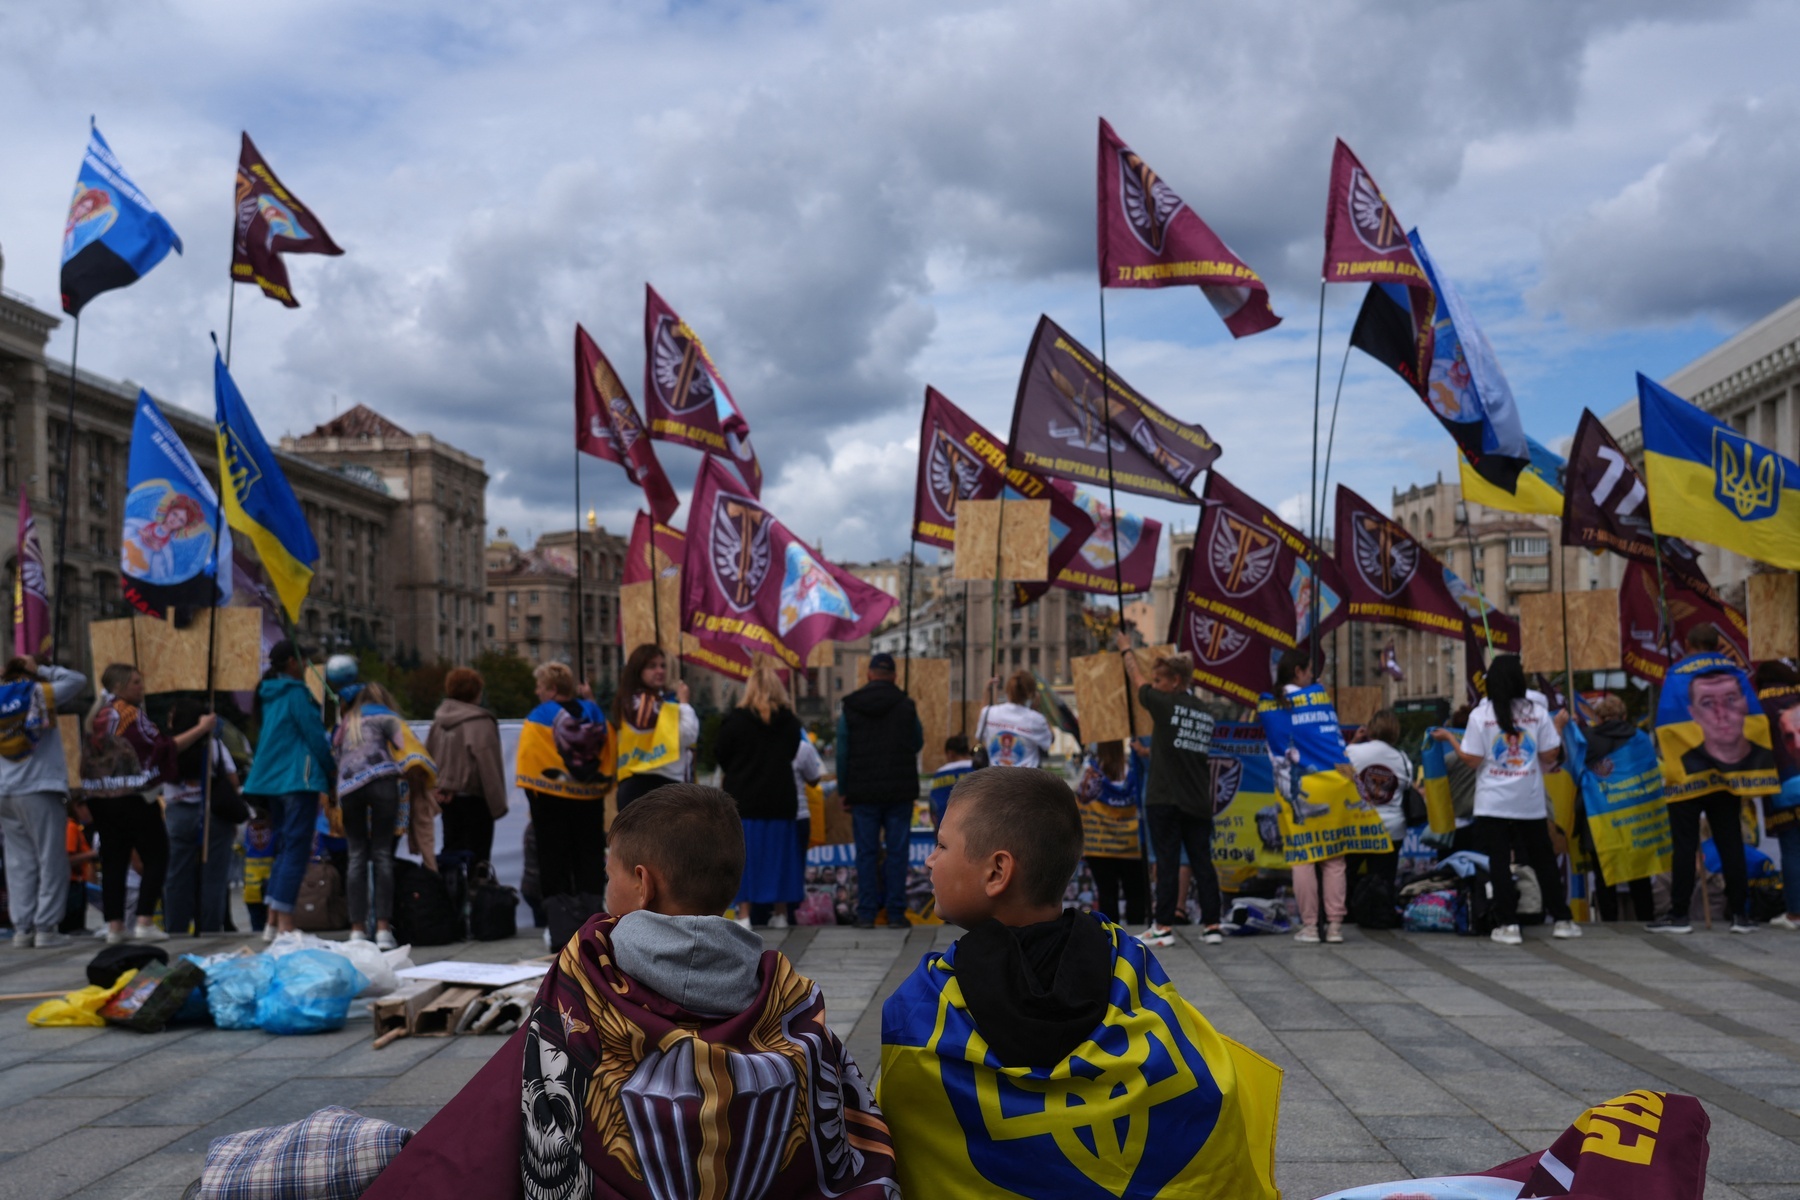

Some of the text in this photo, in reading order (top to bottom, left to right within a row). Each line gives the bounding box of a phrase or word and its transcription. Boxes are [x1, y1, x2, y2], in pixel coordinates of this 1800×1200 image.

[1337, 261, 1349, 276] 77
[1292, 711, 1328, 726] ВИХИЛЬ
[1324, 825, 1356, 842] СЕРЦЕ
[1310, 845, 1324, 858] ТИ
[1326, 838, 1389, 856] ВЕРНЕШСЯ
